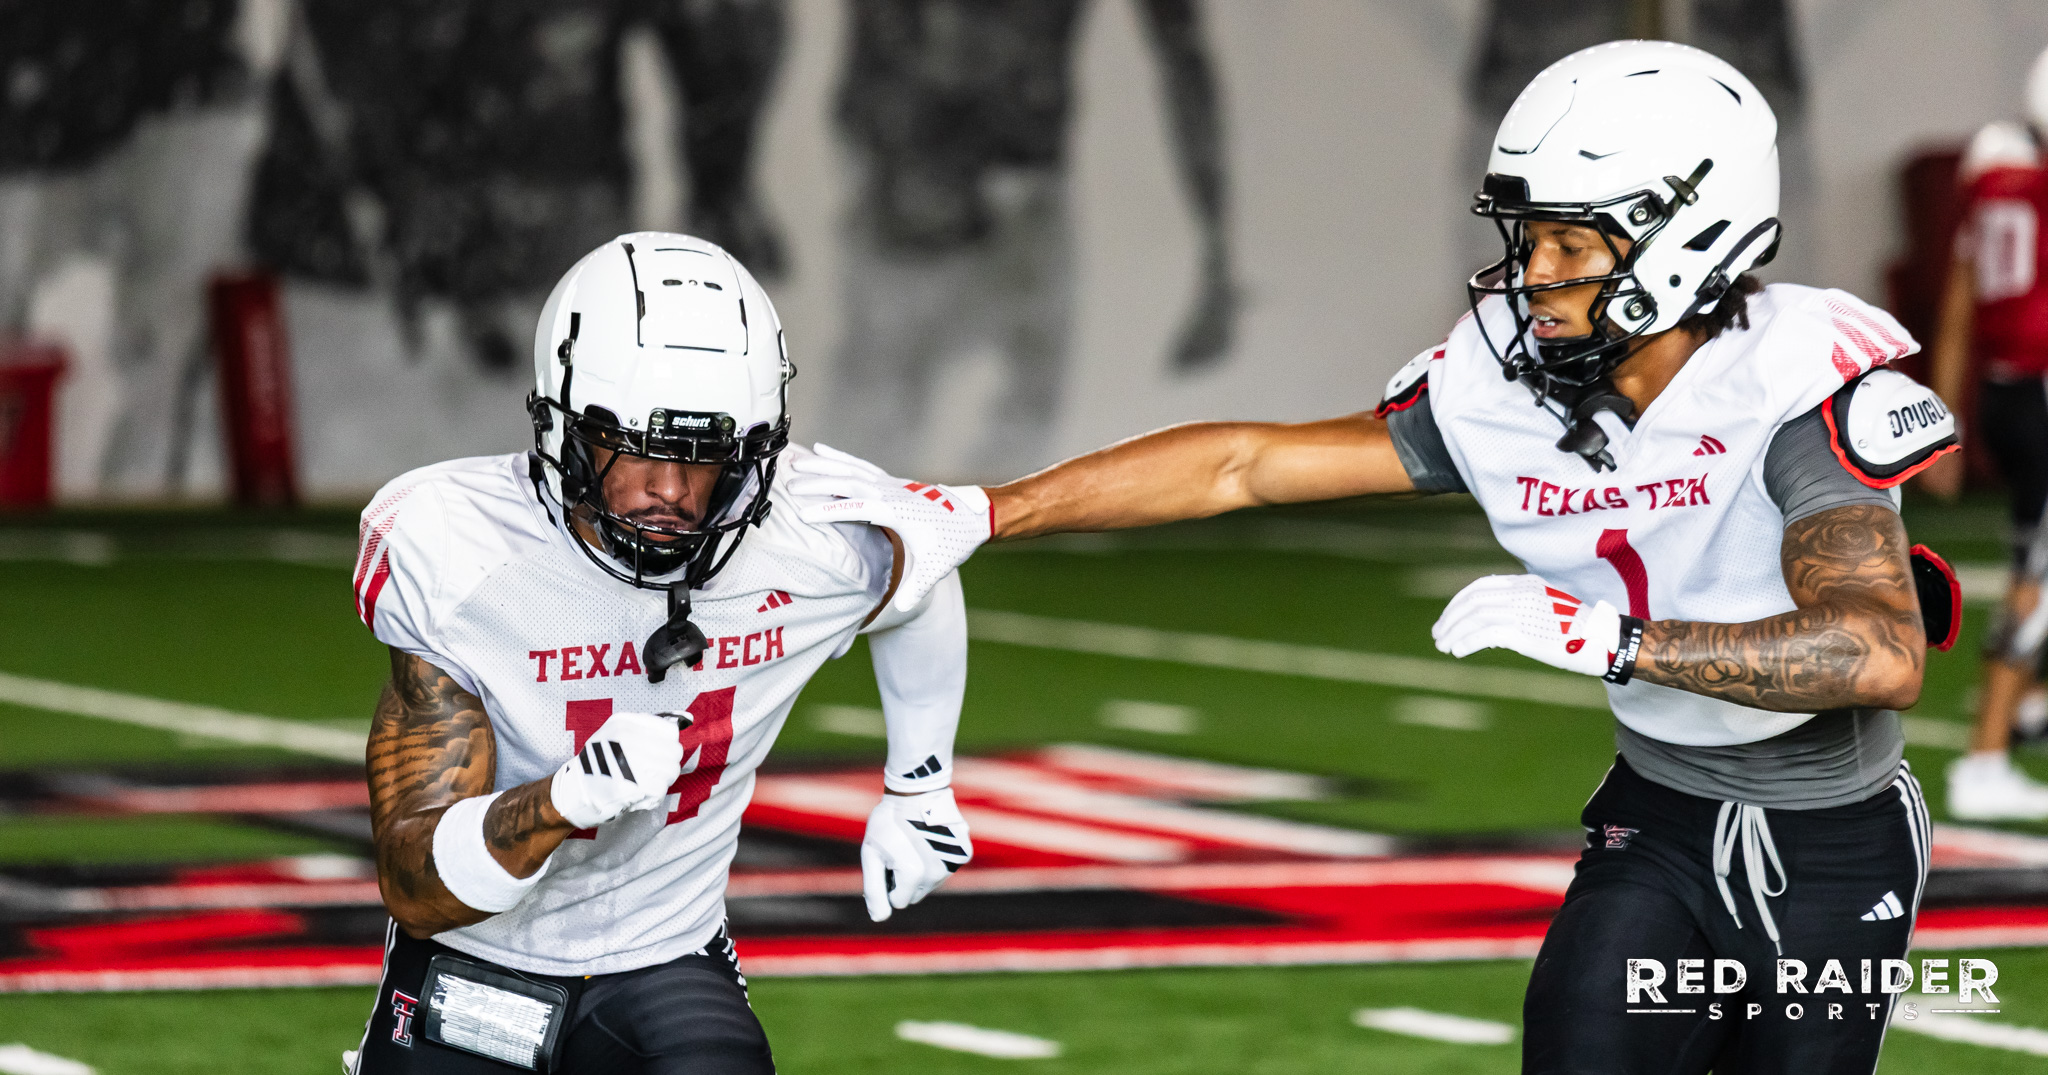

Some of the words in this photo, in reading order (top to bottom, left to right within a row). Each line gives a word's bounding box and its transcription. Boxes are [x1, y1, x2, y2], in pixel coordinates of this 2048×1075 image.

[672, 415, 711, 428] schutt
[1887, 393, 1946, 438] DOUGL
[1516, 476, 1629, 516] TEXAS
[1635, 472, 1711, 510] TEH
[1595, 529, 1650, 620] 1
[529, 641, 649, 682] TEXA
